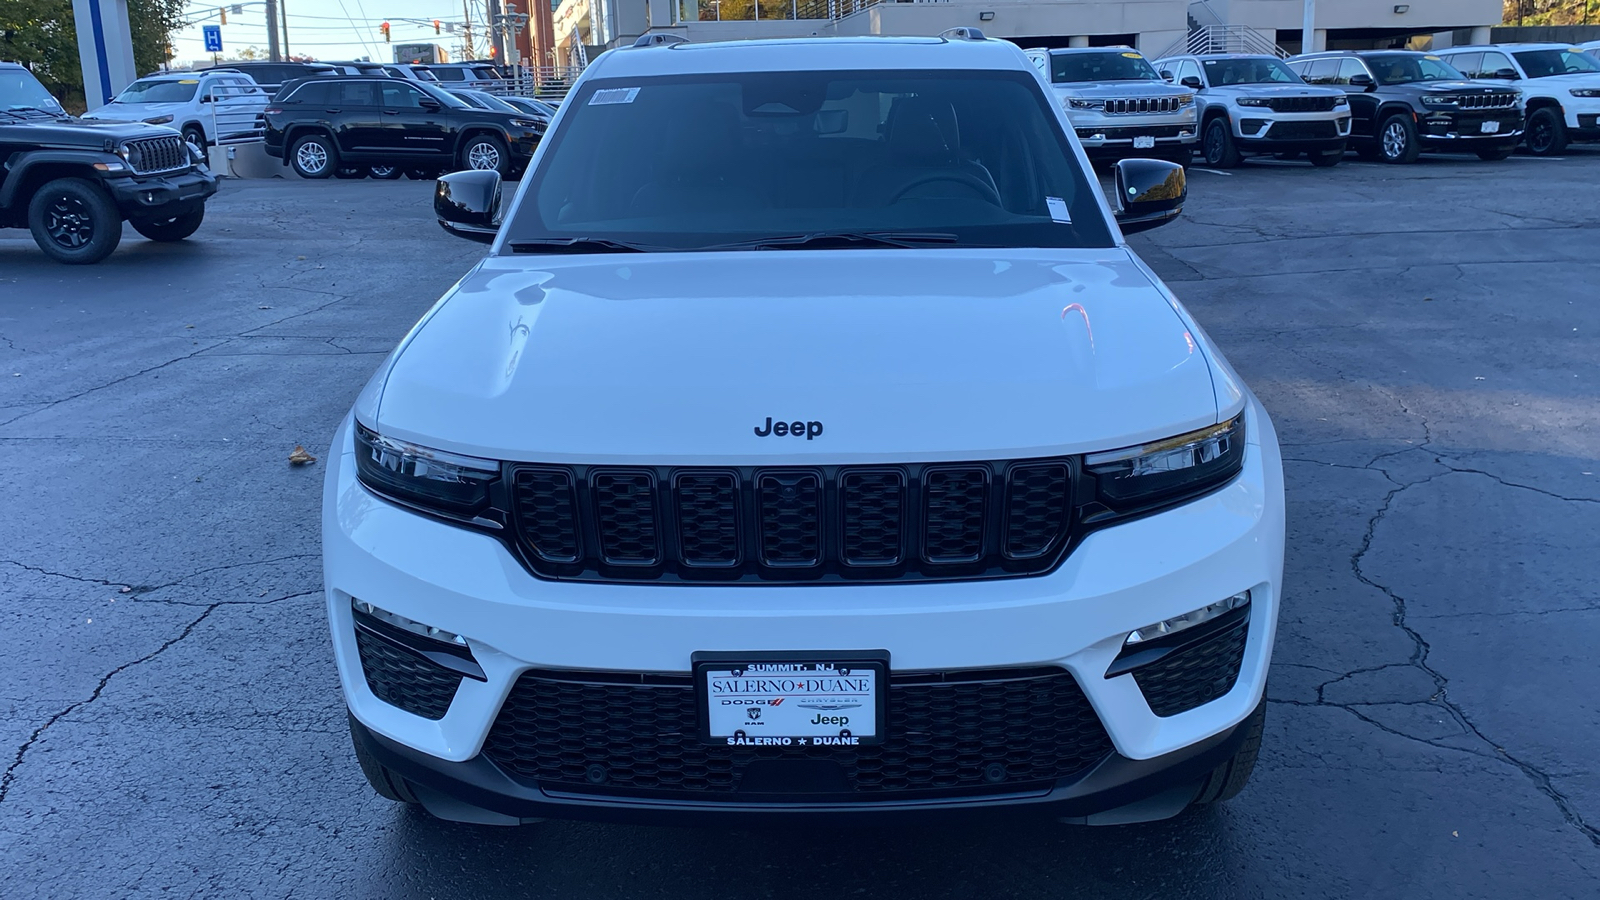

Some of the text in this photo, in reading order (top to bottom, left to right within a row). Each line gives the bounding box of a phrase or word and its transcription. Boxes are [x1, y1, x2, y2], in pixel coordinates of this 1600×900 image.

[207, 31, 219, 45] H
[754, 417, 823, 441] Jeep
[747, 663, 835, 672] SUMMIT, NJ
[712, 679, 870, 693] SALERNO DUANE
[810, 713, 850, 727] Jeep
[727, 737, 859, 746] SALERNO DUANE
